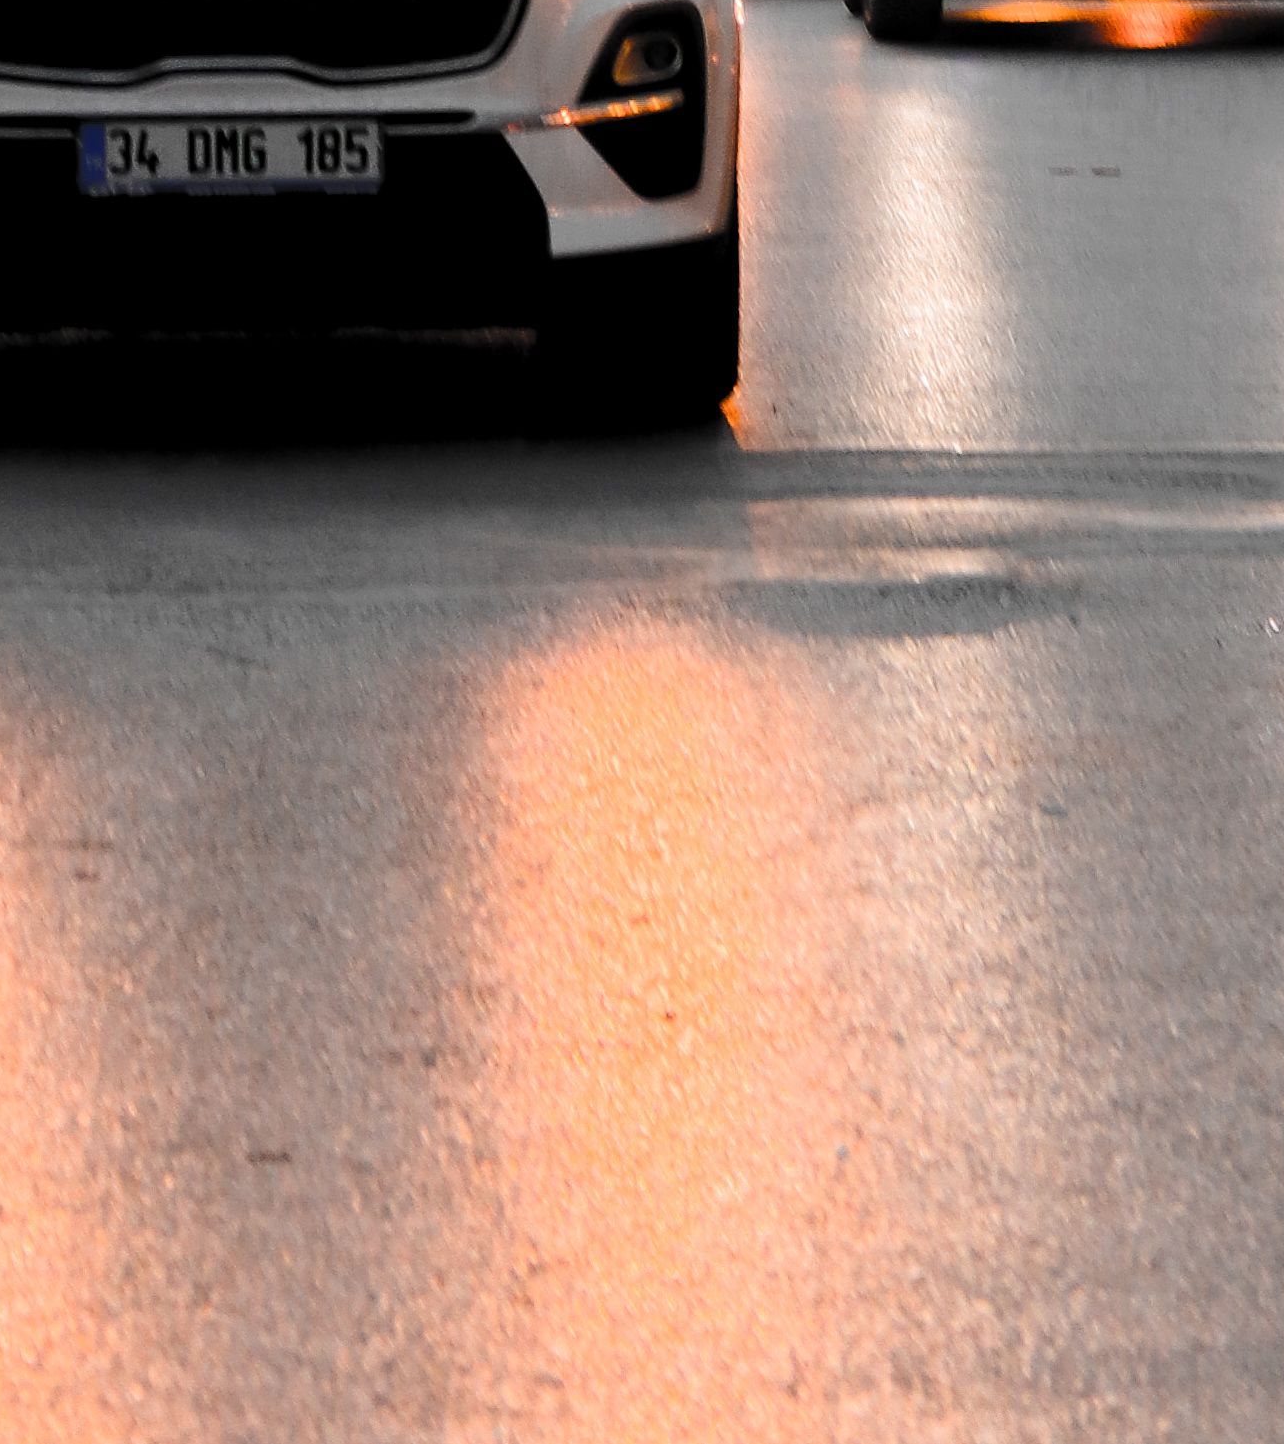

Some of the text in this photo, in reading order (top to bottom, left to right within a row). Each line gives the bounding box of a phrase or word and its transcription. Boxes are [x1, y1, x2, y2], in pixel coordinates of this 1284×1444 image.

[109, 126, 371, 176] 34 DMG 185
